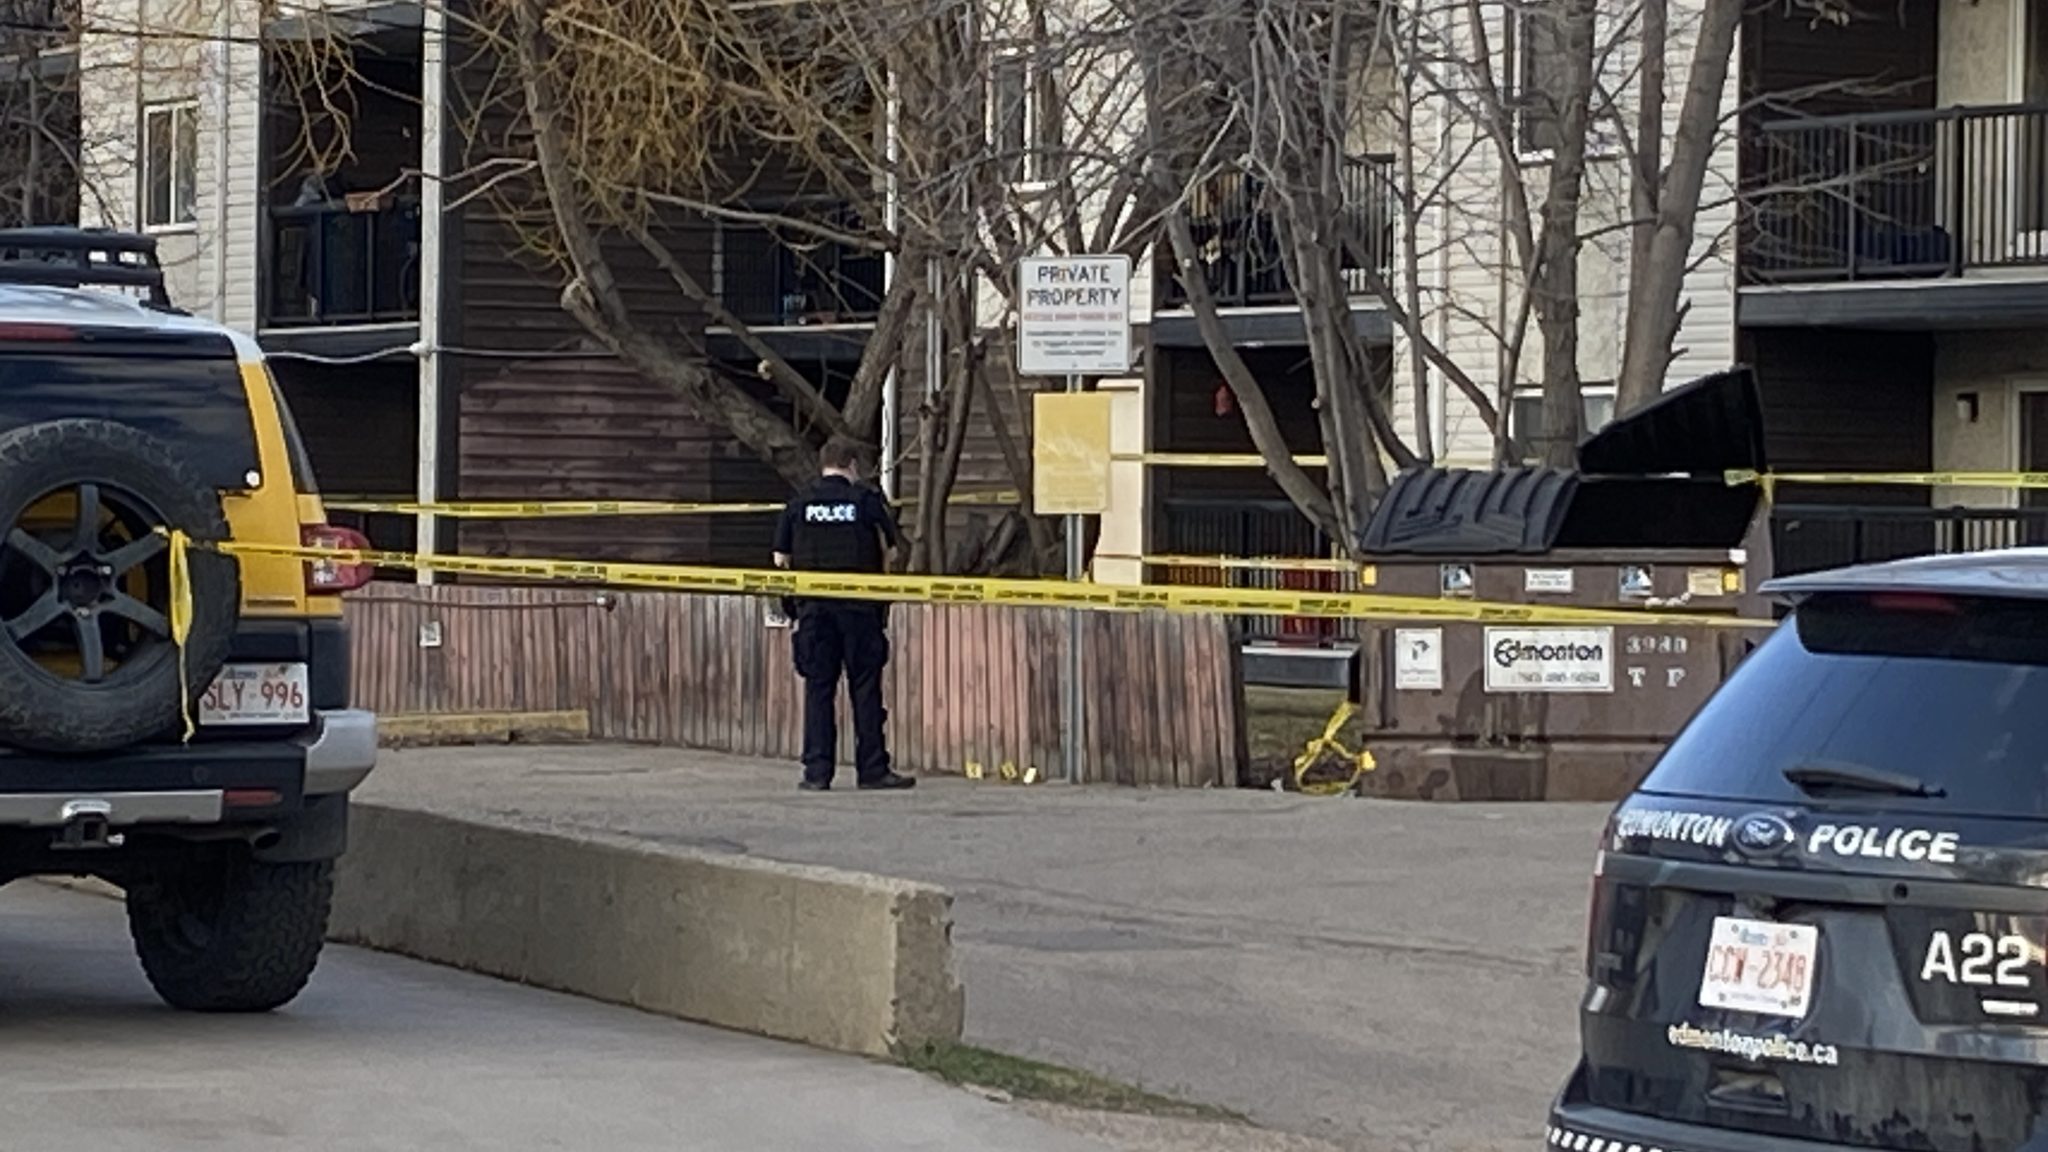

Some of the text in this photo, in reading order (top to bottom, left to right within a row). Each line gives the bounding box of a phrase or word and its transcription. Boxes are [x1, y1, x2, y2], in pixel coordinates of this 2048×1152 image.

[1037, 264, 1111, 284] PRIVATE
[1026, 287, 1121, 307] PROPERTY
[805, 503, 856, 521] POLICE
[1494, 638, 1604, 668] Edmonton
[1627, 666, 1646, 688] T
[1618, 809, 1733, 848] EDMONTON
[1808, 825, 1960, 863] POLICE
[1920, 930, 2031, 987] A22
[1667, 1021, 1839, 1067] edmontonpolice.ca
